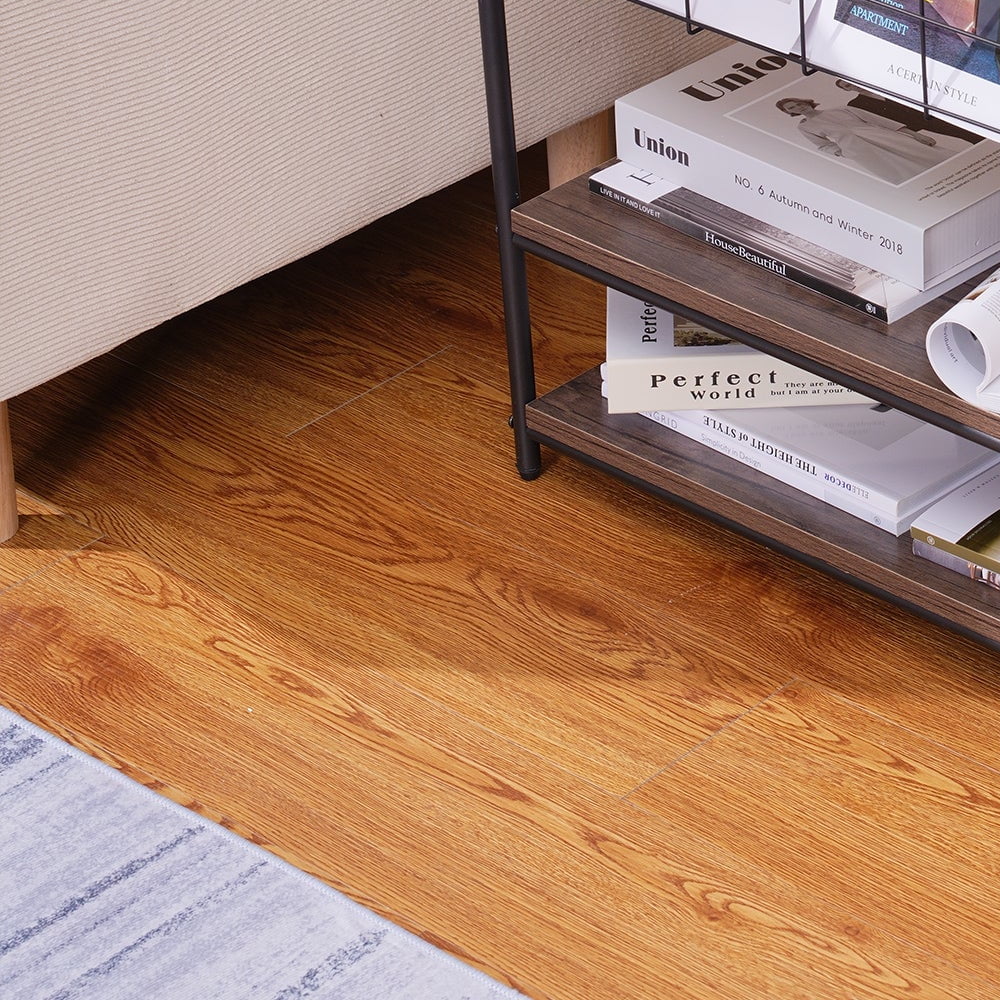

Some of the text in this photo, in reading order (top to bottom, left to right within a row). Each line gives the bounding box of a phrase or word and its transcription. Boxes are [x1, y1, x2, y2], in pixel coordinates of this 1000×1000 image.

[850, 4, 909, 36] APARTMENT
[678, 55, 788, 102] Unio
[886, 63, 978, 107] A CERTIN STYLE
[632, 126, 690, 168] Union
[600, 186, 613, 198] LIVE
[613, 193, 620, 201] IN
[625, 199, 639, 209] AND
[638, 204, 655, 217] LOVE
[654, 211, 661, 219] IT
[734, 173, 904, 256] NO. 6 Autumn and Winter 2018
[704, 230, 787, 277] HouseBeautiful
[640, 301, 657, 343] Perfec
[650, 369, 778, 388] Perfect
[690, 387, 756, 400] World
[703, 415, 737, 439] STYLE
[738, 432, 749, 442] of
[750, 438, 793, 466] HEIGHT
[795, 457, 818, 477] THE
